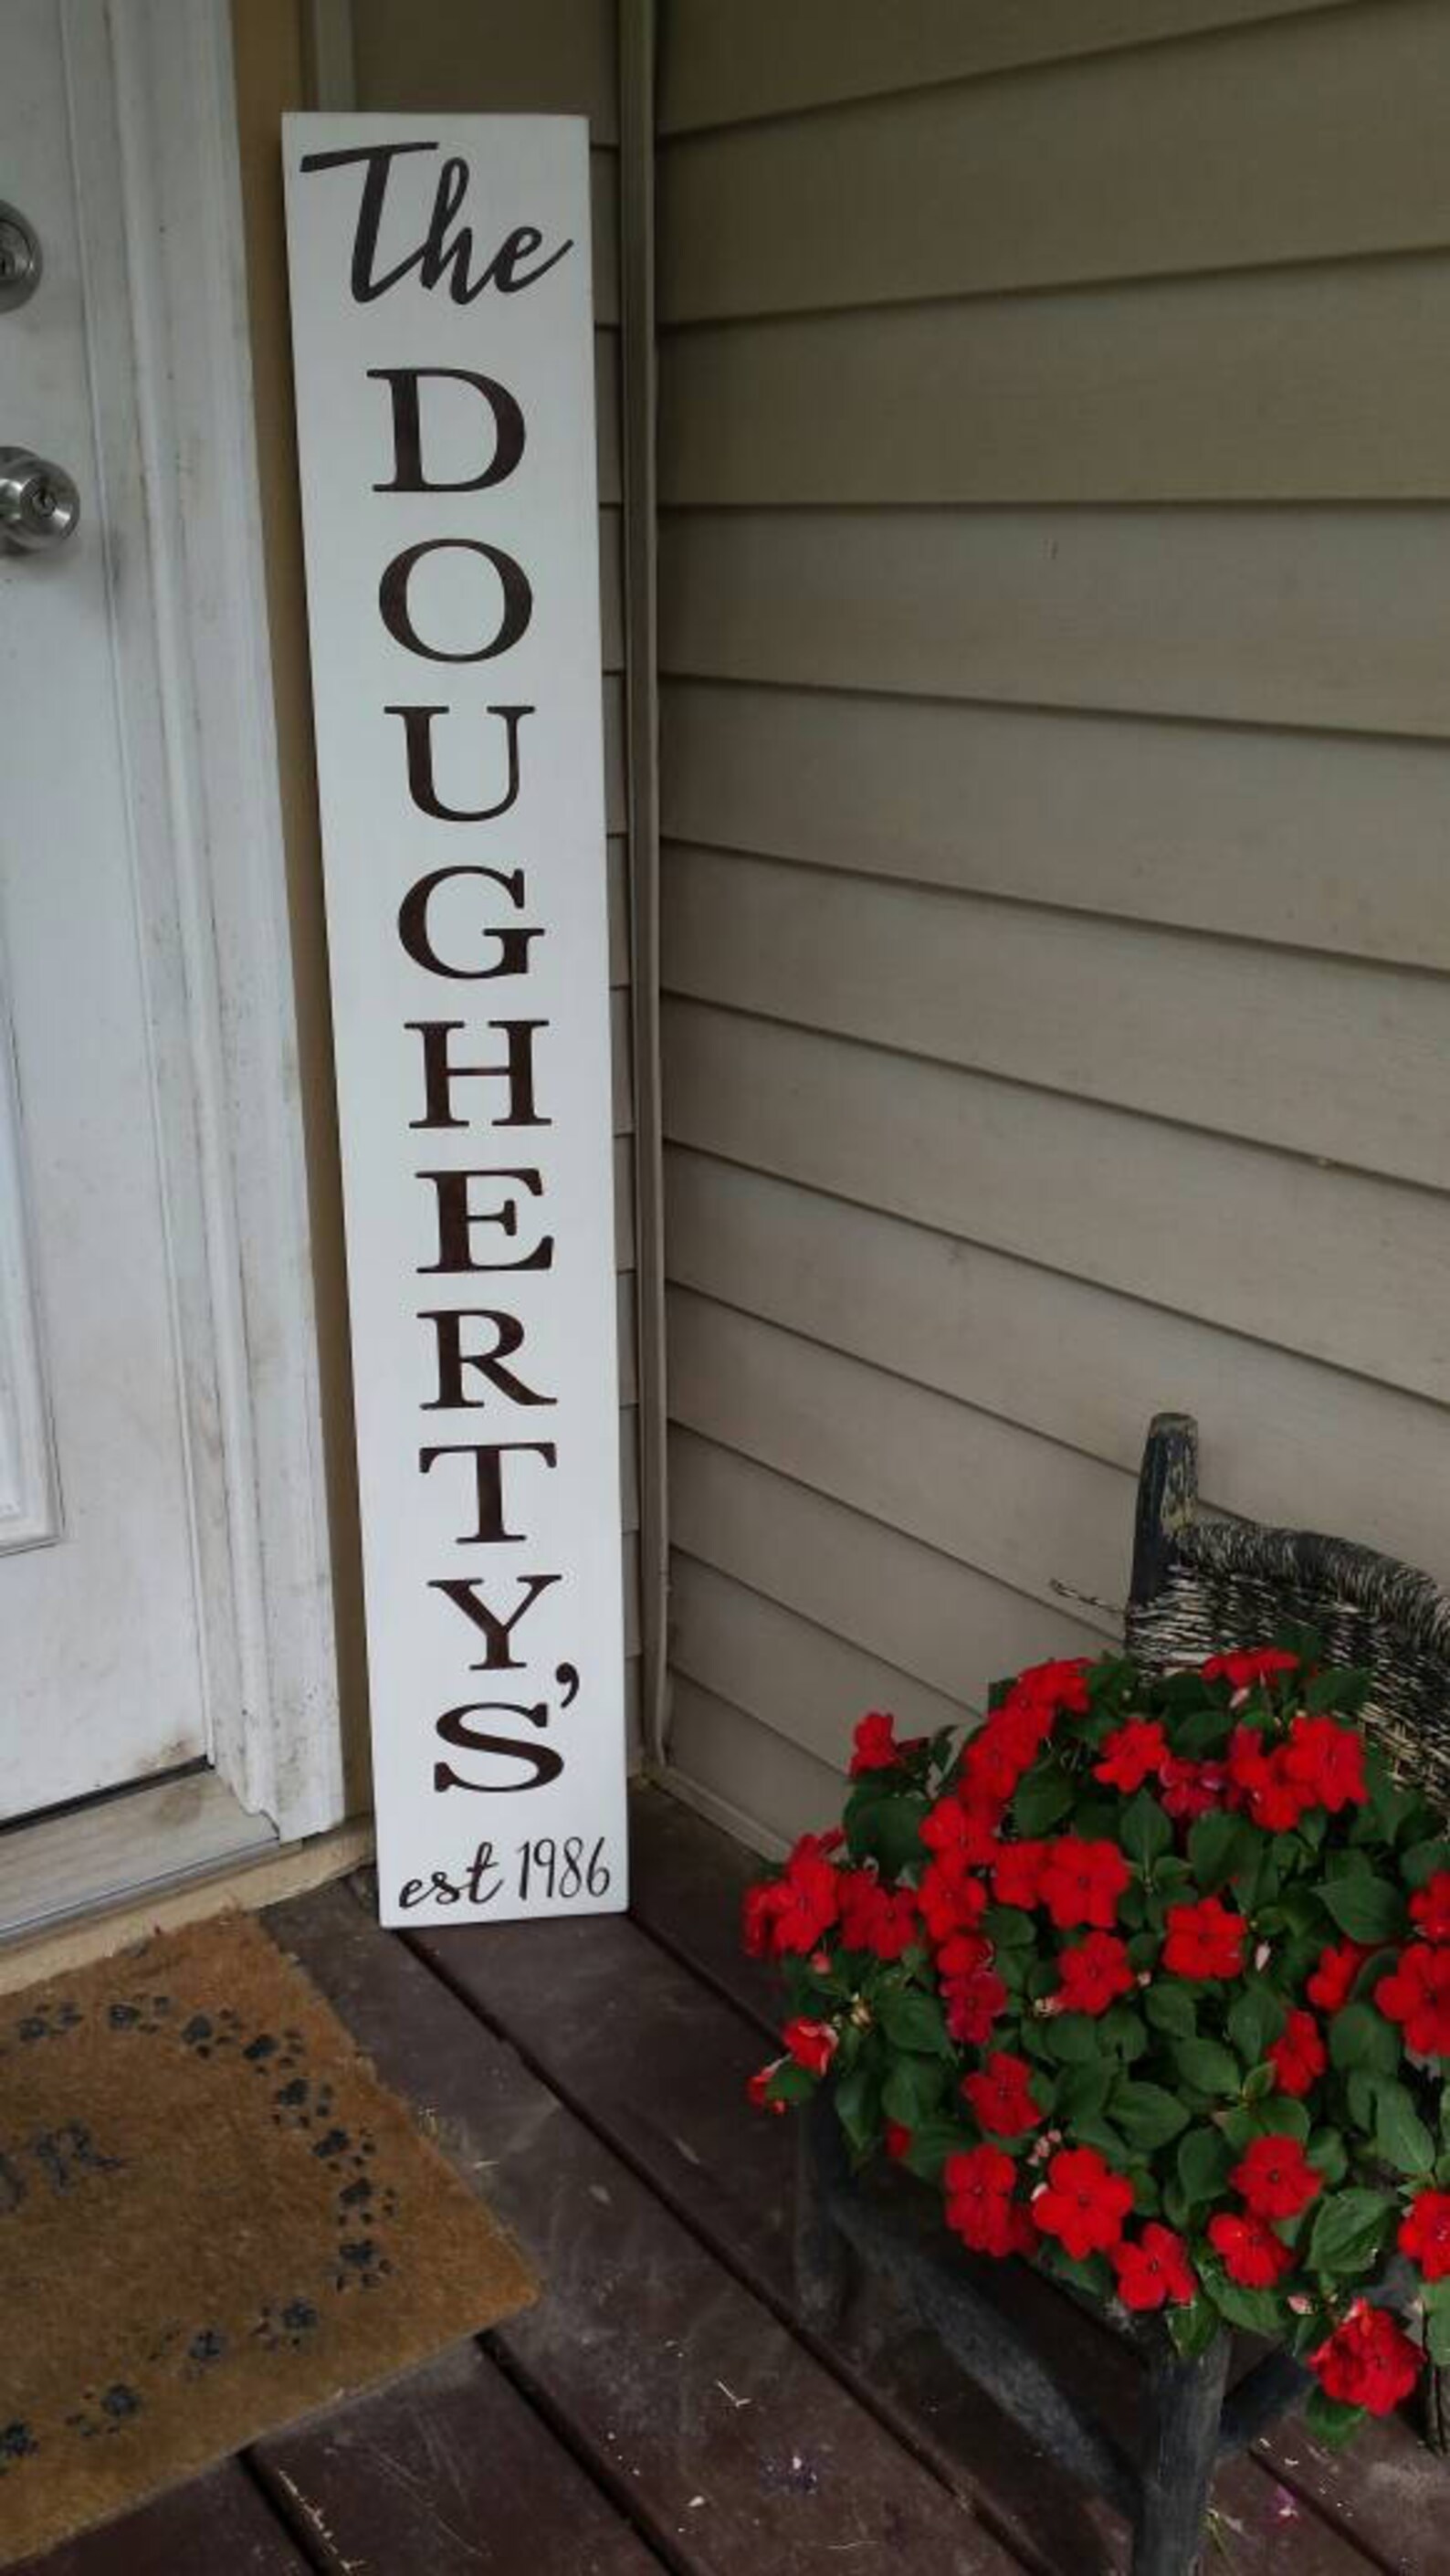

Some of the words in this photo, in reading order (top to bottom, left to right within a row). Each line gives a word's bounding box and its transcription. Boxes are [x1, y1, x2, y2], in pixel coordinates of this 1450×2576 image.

[299, 141, 574, 306] The
[366, 366, 580, 1793] DOUGHERTY'S
[398, 1841, 504, 1909] est
[516, 1835, 611, 1901] 1986
